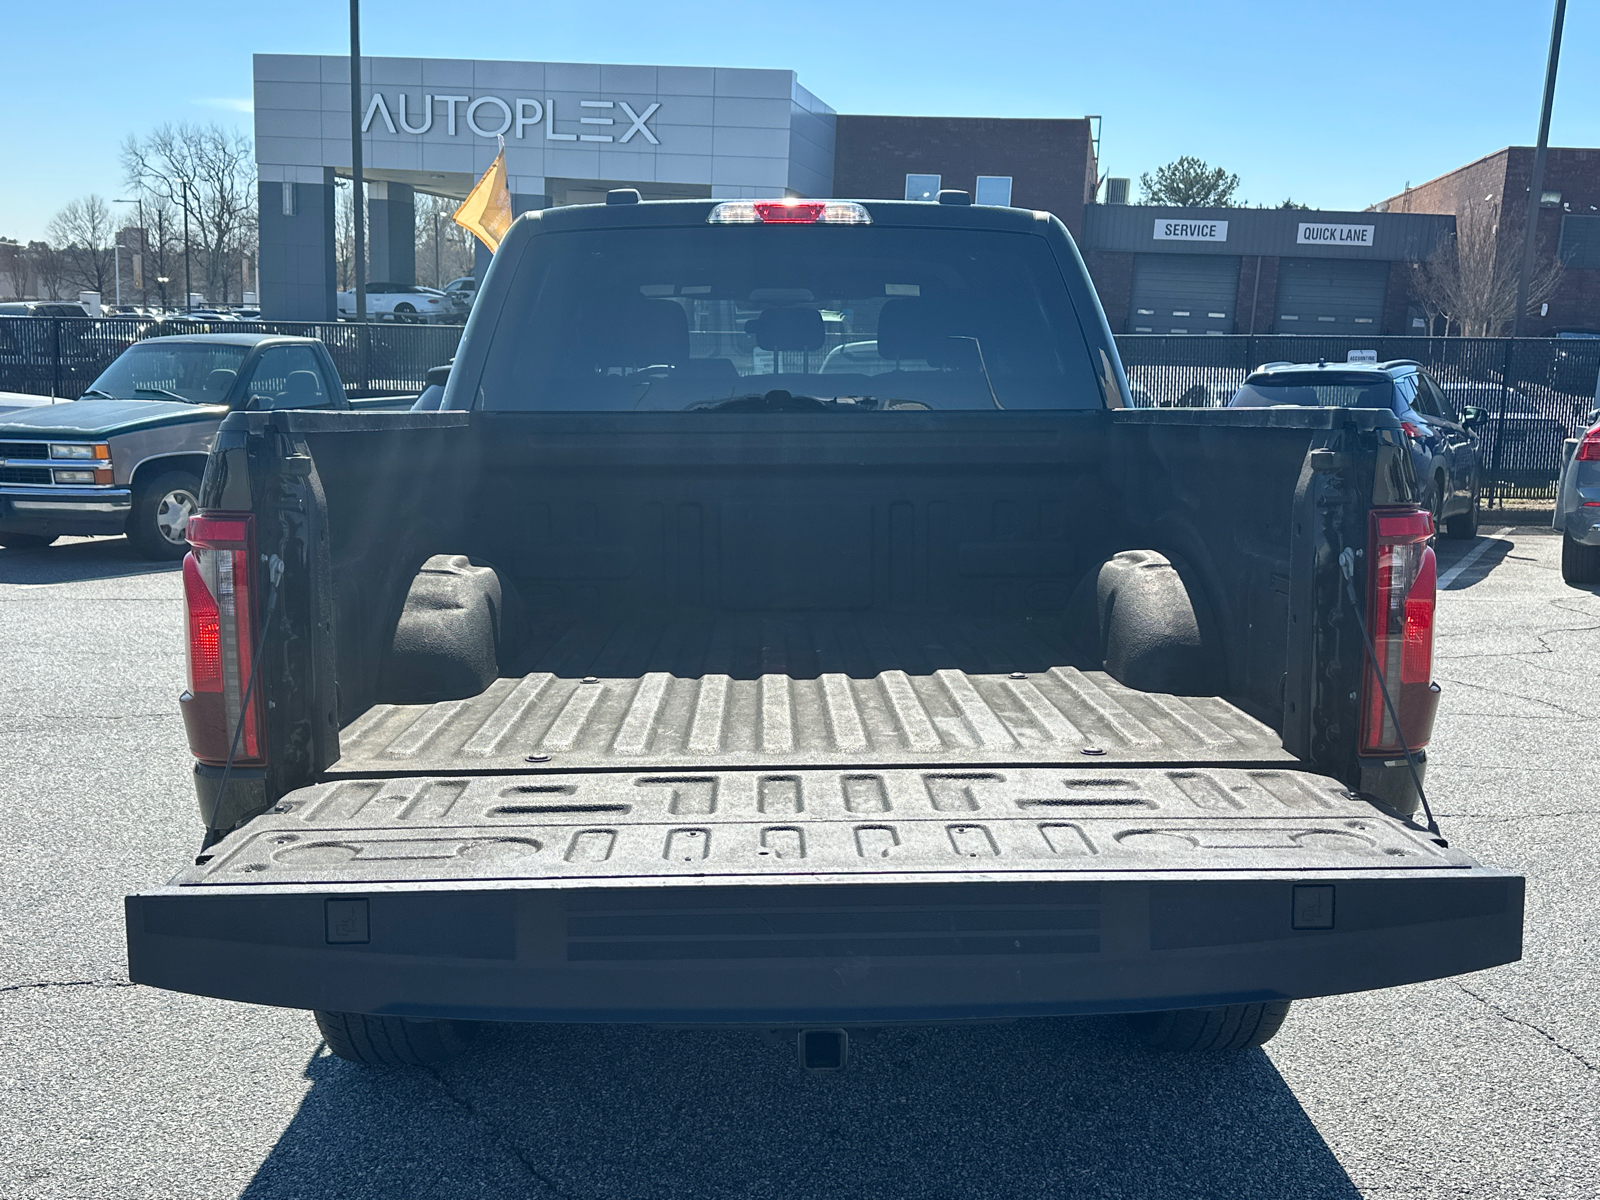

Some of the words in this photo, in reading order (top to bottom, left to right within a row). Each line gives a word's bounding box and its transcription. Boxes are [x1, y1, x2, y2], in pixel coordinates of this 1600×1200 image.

[361, 93, 661, 144] AUTOPLEX
[1164, 223, 1217, 238] SERVICE
[1303, 227, 1337, 241] QUICK
[1339, 228, 1368, 242] LANE
